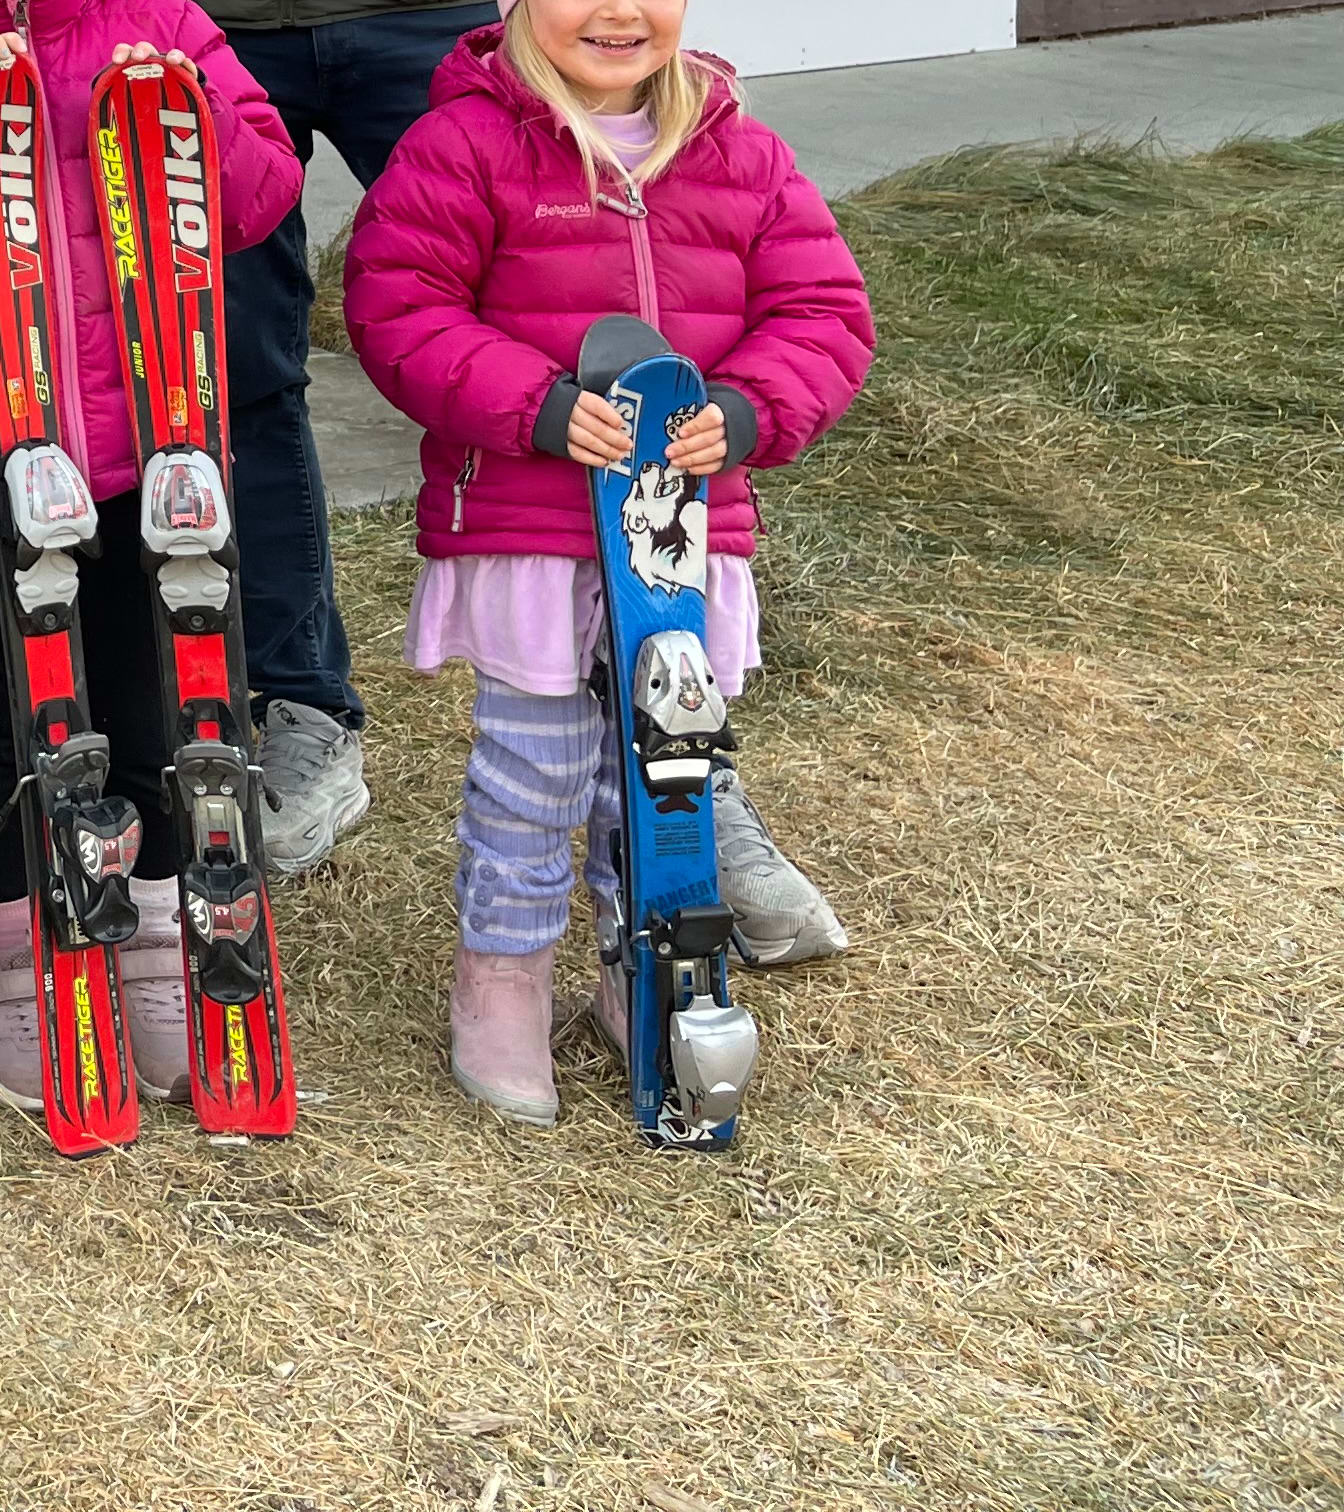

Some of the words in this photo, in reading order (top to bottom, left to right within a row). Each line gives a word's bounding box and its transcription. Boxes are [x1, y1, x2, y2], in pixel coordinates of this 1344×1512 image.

[534, 201, 592, 219] Bergans
[131, 339, 146, 379] JUNIOR
[36, 369, 50, 406] GS
[196, 374, 213, 410] GS
[43, 972, 54, 992] 900
[73, 973, 100, 1100] RACETIGER
